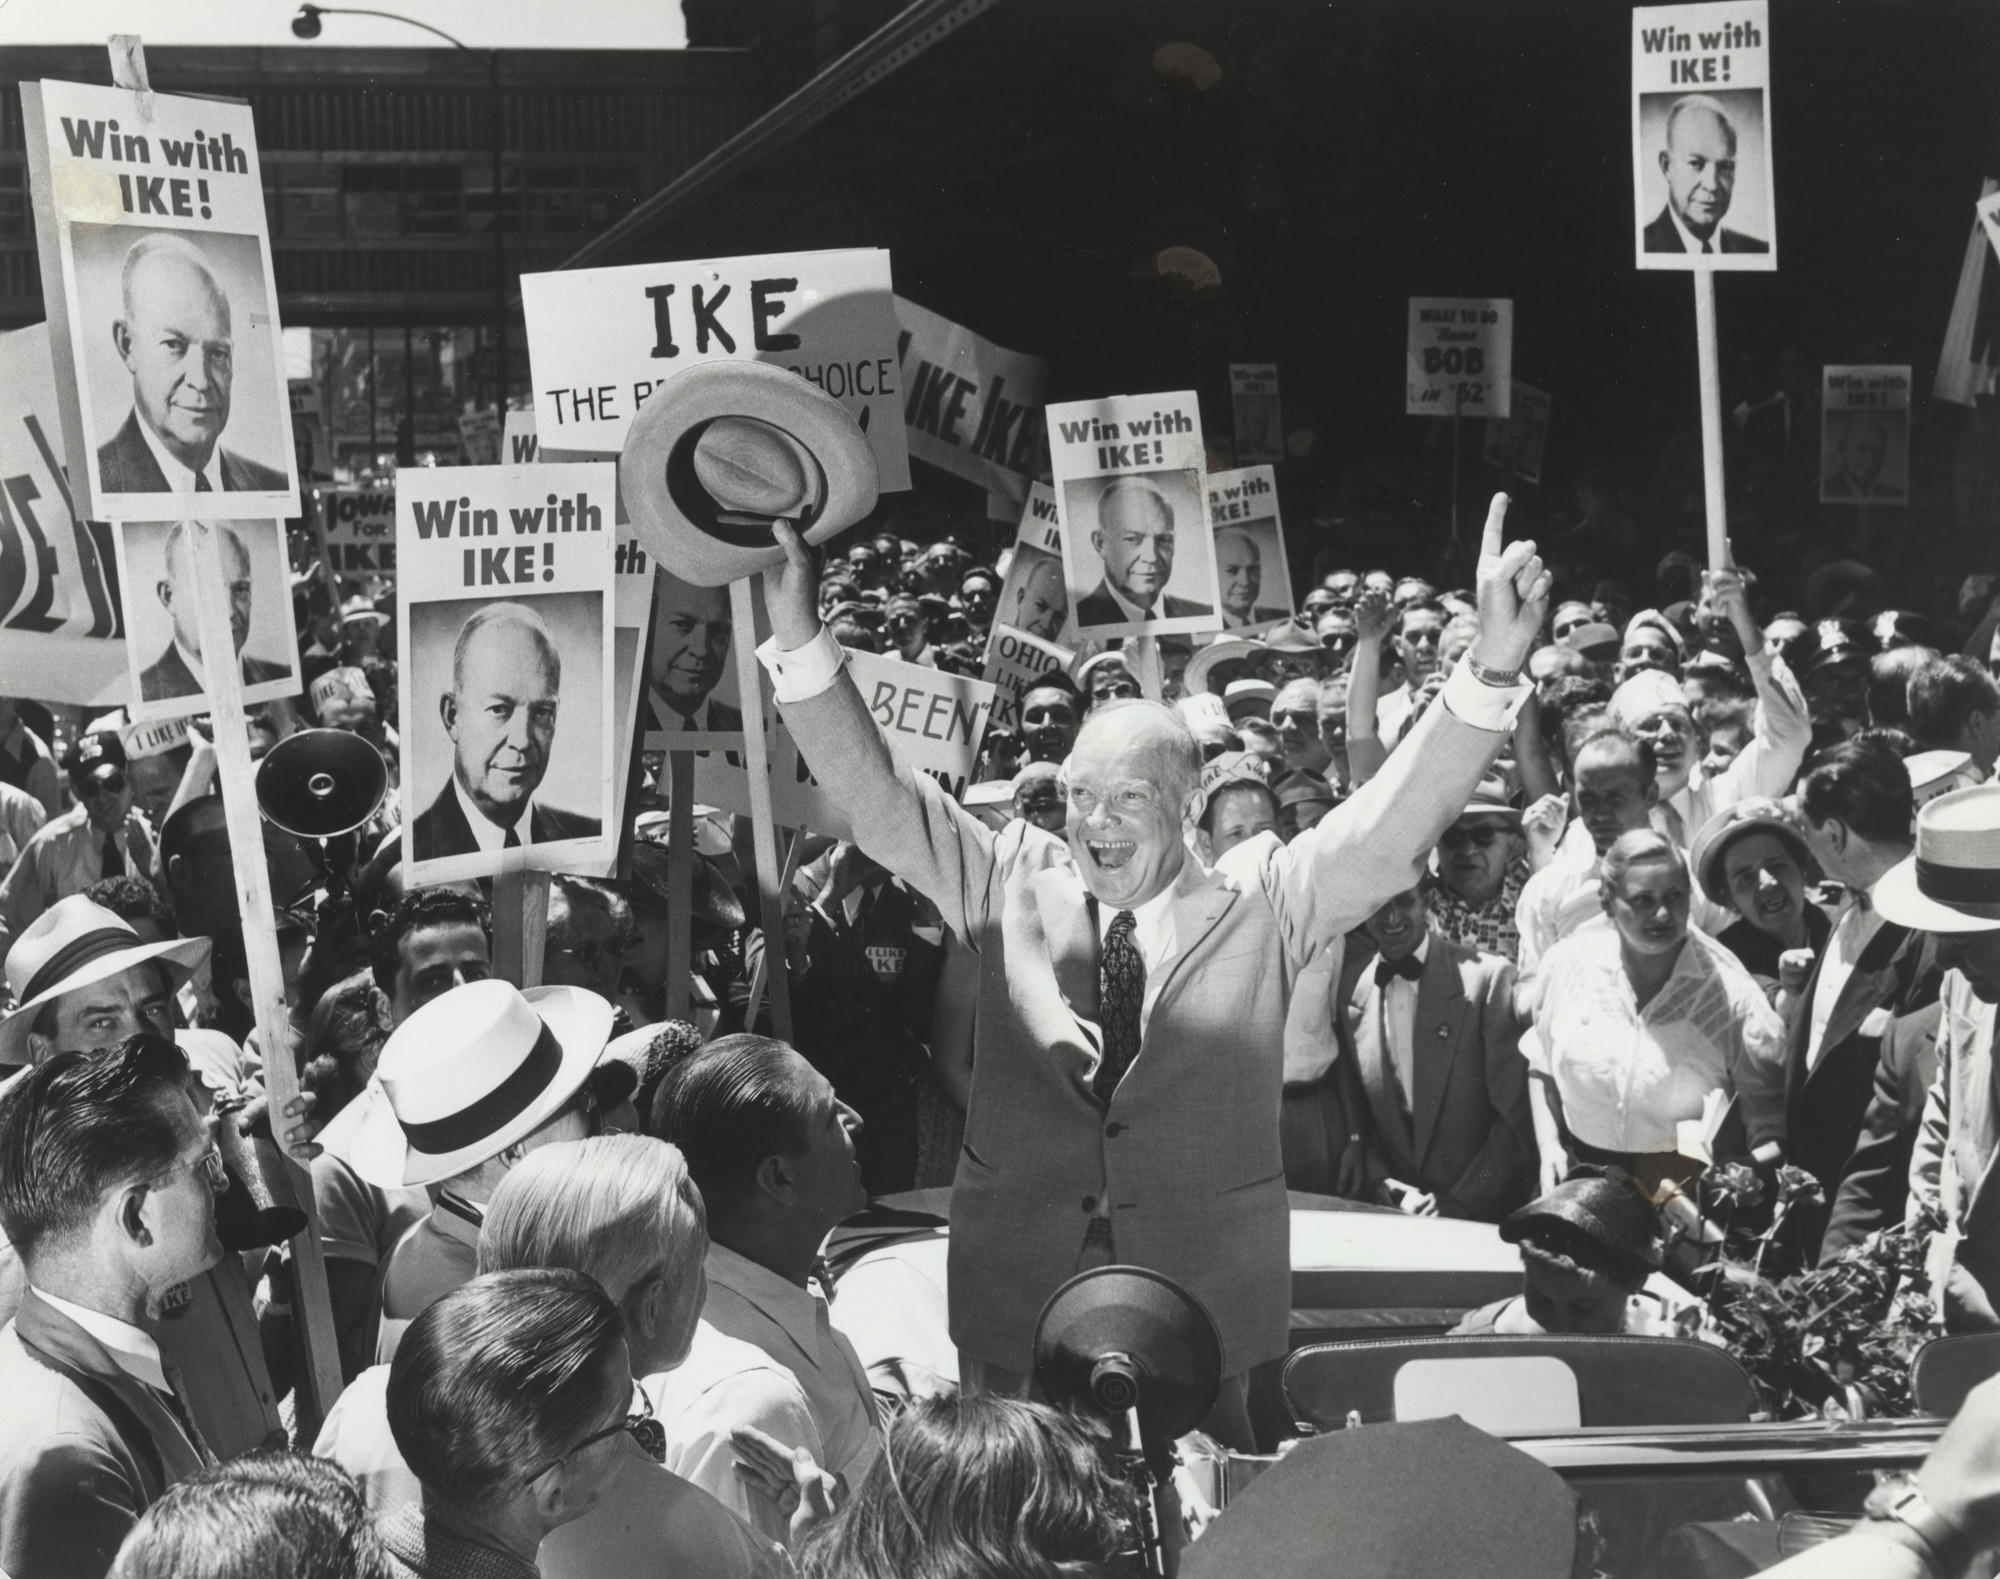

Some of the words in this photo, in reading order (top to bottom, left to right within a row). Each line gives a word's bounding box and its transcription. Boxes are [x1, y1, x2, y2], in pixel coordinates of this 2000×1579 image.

[1642, 26, 1691, 53] Win
[1698, 20, 1761, 50] with
[1670, 55, 1731, 84] IKE!
[60, 116, 151, 164] Win
[159, 129, 248, 174] with
[118, 174, 212, 220] IKE!
[645, 278, 800, 358] IKE
[1423, 346, 1485, 376] BOB
[546, 386, 620, 424] THE
[1059, 417, 1120, 444] Win
[1127, 410, 1192, 437] with
[1097, 441, 1164, 469] IKE!
[1223, 477, 1271, 500] with
[411, 496, 498, 539] Win
[509, 493, 602, 534] with
[1212, 500, 1251, 522] KE!
[463, 542, 555, 587] IKE!
[615, 539, 646, 574] th
